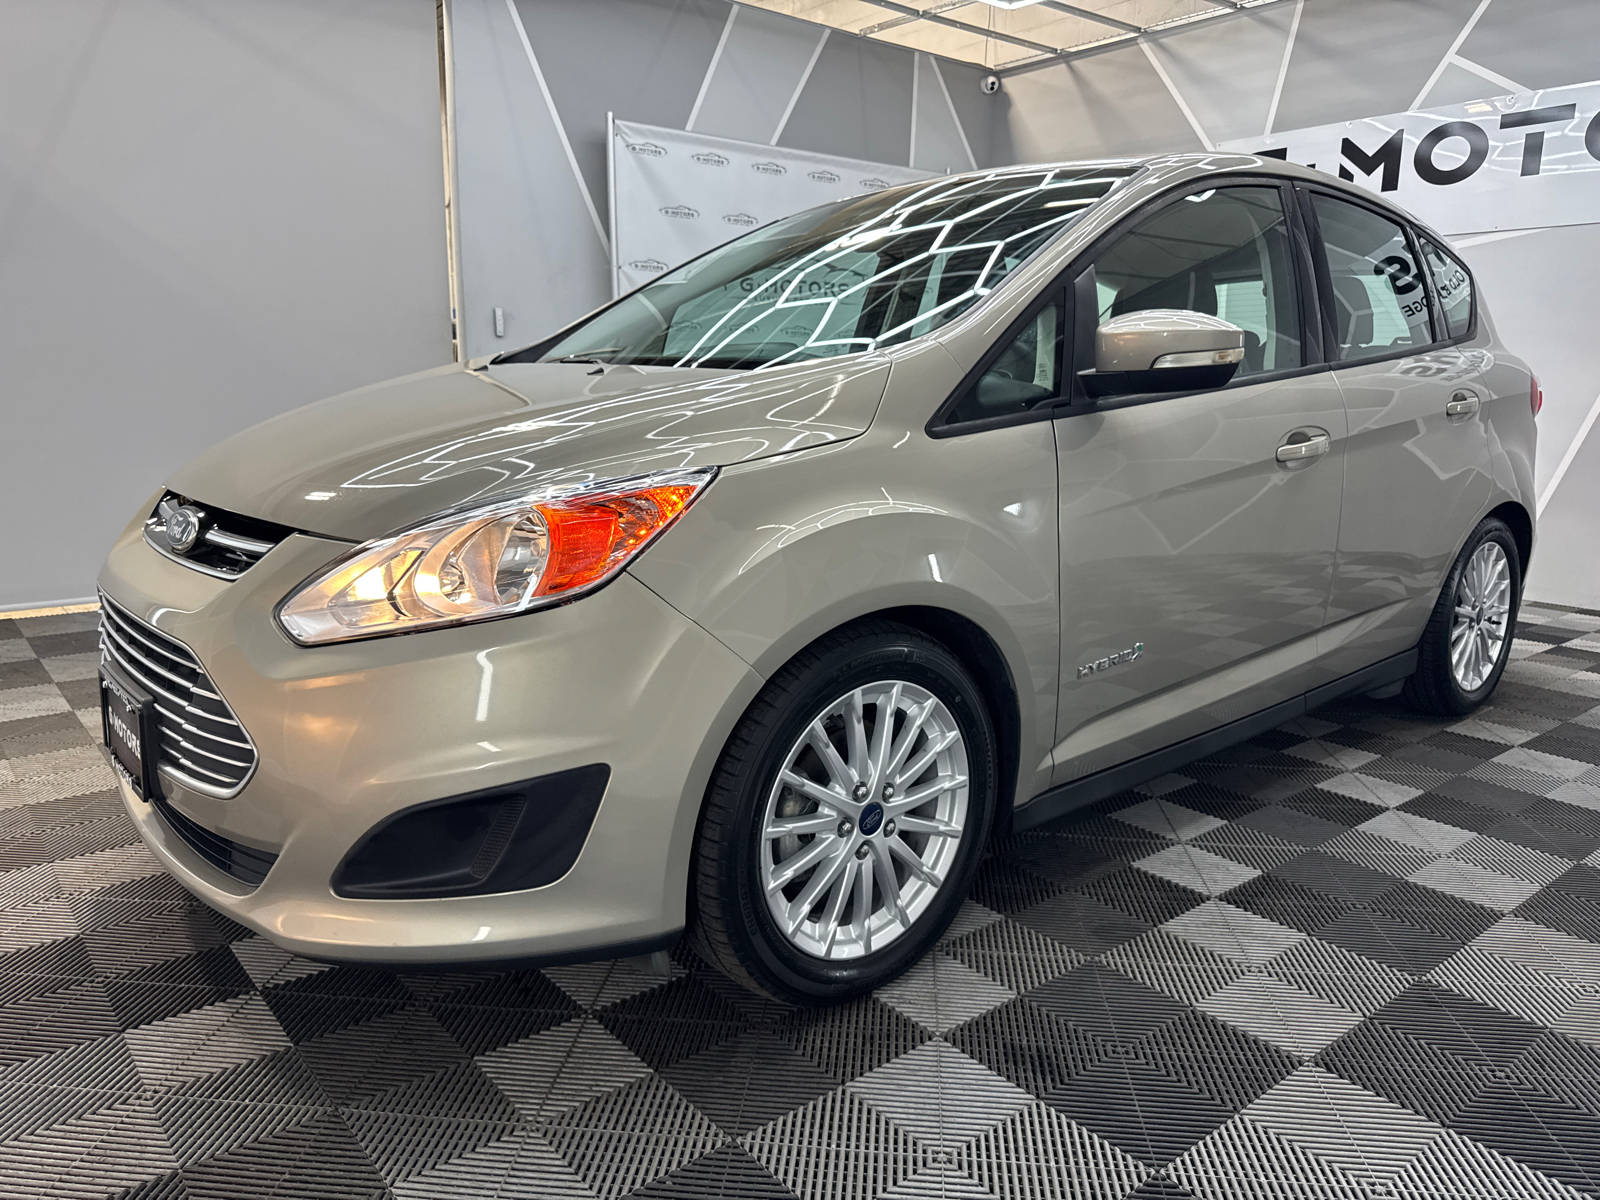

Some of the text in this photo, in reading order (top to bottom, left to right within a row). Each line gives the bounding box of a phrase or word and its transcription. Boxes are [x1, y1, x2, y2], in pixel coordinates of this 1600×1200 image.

[167, 513, 186, 539] Ford
[1076, 648, 1133, 680] HYBRID
[739, 882, 758, 936] ENERGY
